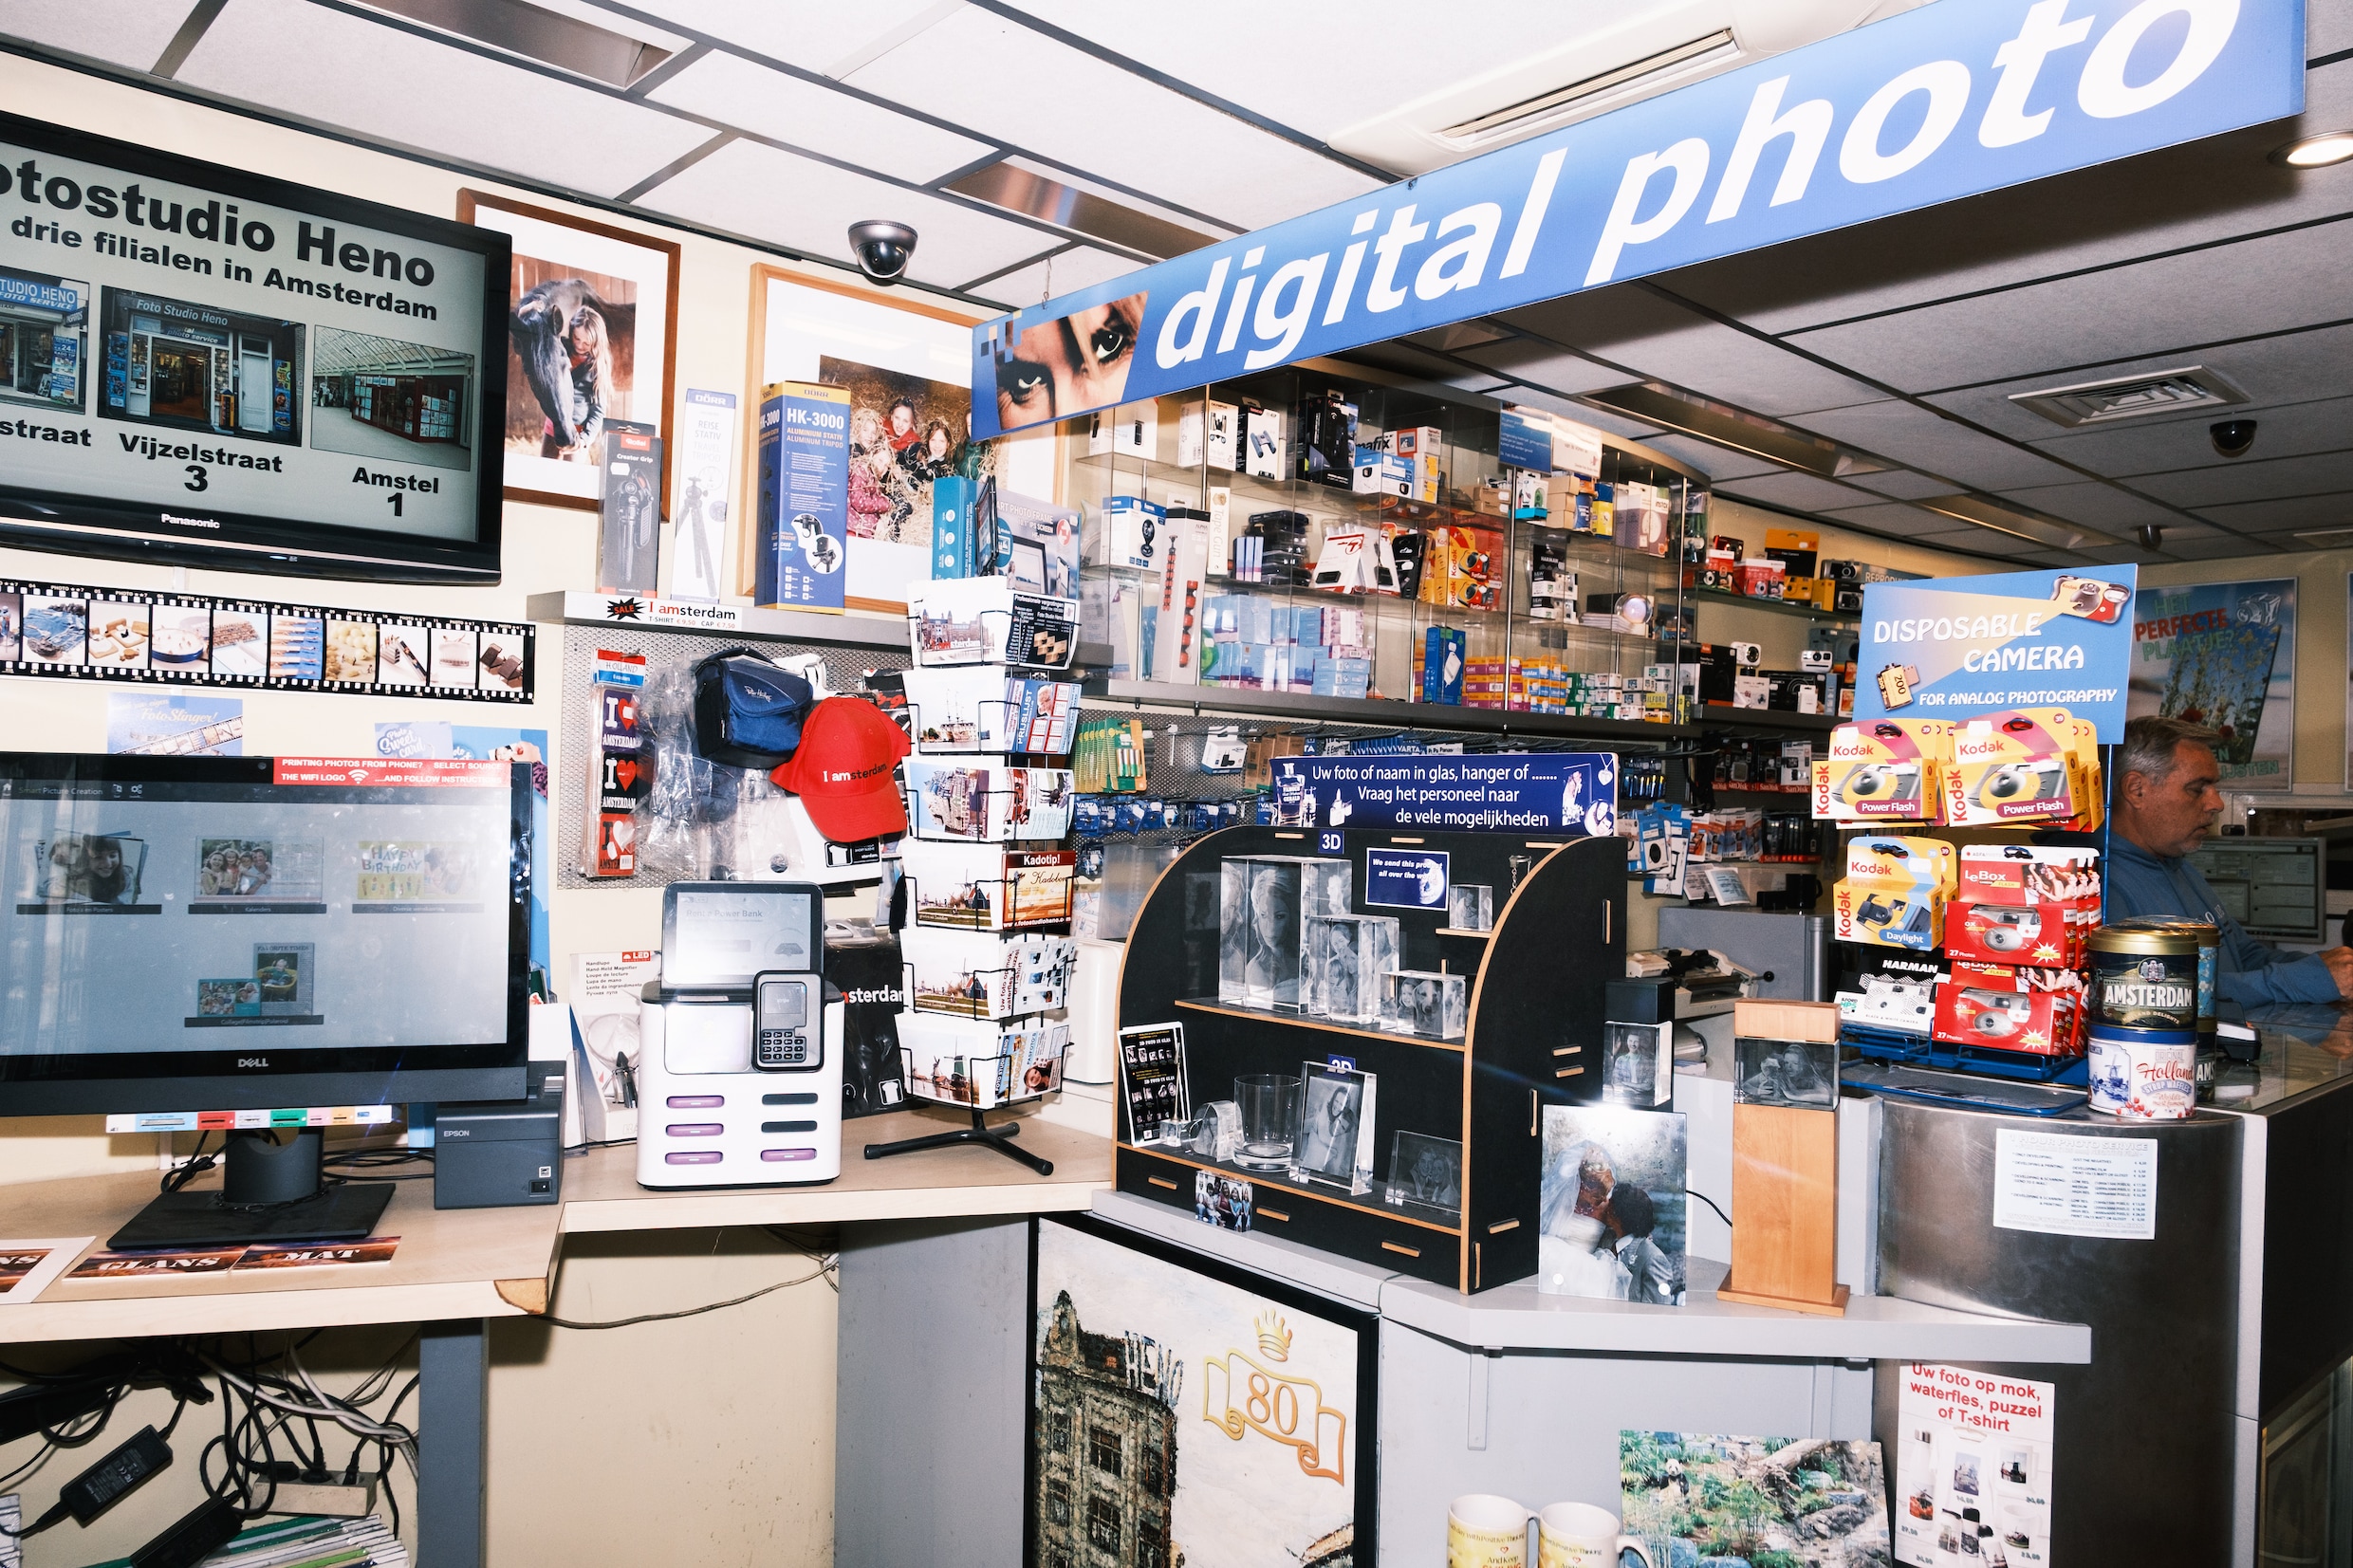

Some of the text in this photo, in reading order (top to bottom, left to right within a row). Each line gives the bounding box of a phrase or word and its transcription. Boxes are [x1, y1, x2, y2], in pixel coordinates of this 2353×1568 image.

[1152, 0, 2239, 373] digital photo
[298, 221, 435, 287] Heno
[11, 216, 436, 321] drie filialen in Amsterdam
[136, 299, 229, 326] Foto Studio Heno
[695, 393, 727, 406] DÖRR
[804, 389, 829, 397] DÖRR
[697, 419, 720, 432] REISE
[787, 408, 844, 430] HK-3000
[625, 437, 647, 447] Rollei
[695, 430, 722, 441] STATIV
[787, 427, 843, 441] ALUMINIUM STATIV
[787, 434, 843, 449] ALUMINUM TRIPOD
[119, 433, 283, 474] Vijzelstraat
[352, 466, 439, 494] Amstel
[617, 452, 654, 464] Creator Grip
[184, 466, 403, 517] 3 1
[160, 512, 220, 529] Panasonic
[1010, 504, 1032, 518] PHOTO
[1033, 510, 1054, 524] FRAME
[1214, 508, 1225, 558] Tape Gun
[613, 601, 736, 620] SALE I amsterdam
[2154, 593, 2191, 618] HET
[1874, 612, 2043, 643] DISPOSABLE
[2135, 608, 2228, 642] PERFECTE
[2142, 630, 2235, 661] PLAATJE?
[605, 661, 639, 673] HOLLAND
[1963, 645, 2085, 673] CAMERA
[1894, 674, 1907, 695] 200
[1918, 689, 2118, 706] FOR ANALOG PHOTOGRAPHY
[2054, 714, 2065, 723] 39
[387, 728, 408, 741] Photo
[1921, 725, 1931, 734] 39
[380, 732, 419, 755] Sweet
[398, 740, 426, 759] card
[1397, 745, 1420, 753] VARTA
[1833, 745, 1874, 757] Kodak
[1959, 741, 2005, 756] Kodak
[283, 759, 323, 767] PRINTING
[389, 761, 423, 769] PHONE?
[468, 762, 502, 770] SOURCE
[301, 773, 319, 782] WIFI
[320, 773, 345, 782] LOGO
[404, 775, 439, 784] FOLLOW
[1312, 766, 1332, 781] Uw
[1334, 765, 1359, 781] foto
[1361, 764, 1375, 781] of
[1377, 768, 1411, 781] naam
[1414, 766, 1426, 781] in
[1429, 765, 1458, 784] glas,
[1462, 764, 1512, 784] hanger
[1514, 764, 1529, 781] of
[1358, 785, 1520, 806] Vraag het personeel naar
[1816, 766, 1829, 815] Kodak
[1947, 769, 1967, 822] Kodak
[602, 796, 637, 810] AMSTERDAM
[1862, 802, 1916, 813] Power Flash
[2003, 800, 2065, 816] Power Flash
[1396, 808, 1549, 830] de vele mogelijkheden
[1321, 833, 1342, 851] 3D
[1024, 854, 1061, 867] Kadotip!
[1851, 861, 1892, 876] Kodak
[1965, 870, 2007, 881] LeBox
[686, 910, 707, 918] Rent
[714, 910, 740, 918] Power
[742, 910, 764, 918] Bank
[1838, 891, 1851, 937] Kodak
[1886, 931, 1924, 944] Daylight
[1882, 959, 1938, 973] HARMAN
[2104, 985, 2193, 1007] AMSTERDAM
[2152, 1010, 2180, 1024] DELIGHTS
[237, 1058, 269, 1069] DELL
[2155, 1051, 2185, 1061] ORIGINAL
[2136, 1060, 2195, 1082] Holland
[2019, 1135, 2148, 1151] HOUR PHOTO SERVICE
[100, 1257, 221, 1271] GLANS
[1125, 1330, 1184, 1408] HENO
[1912, 1362, 2041, 1401] Uw foto op mok,
[1247, 1372, 1299, 1435] 80
[1910, 1381, 2042, 1418] waterfles, puzzel
[1938, 1406, 2010, 1432] of T-shirt
